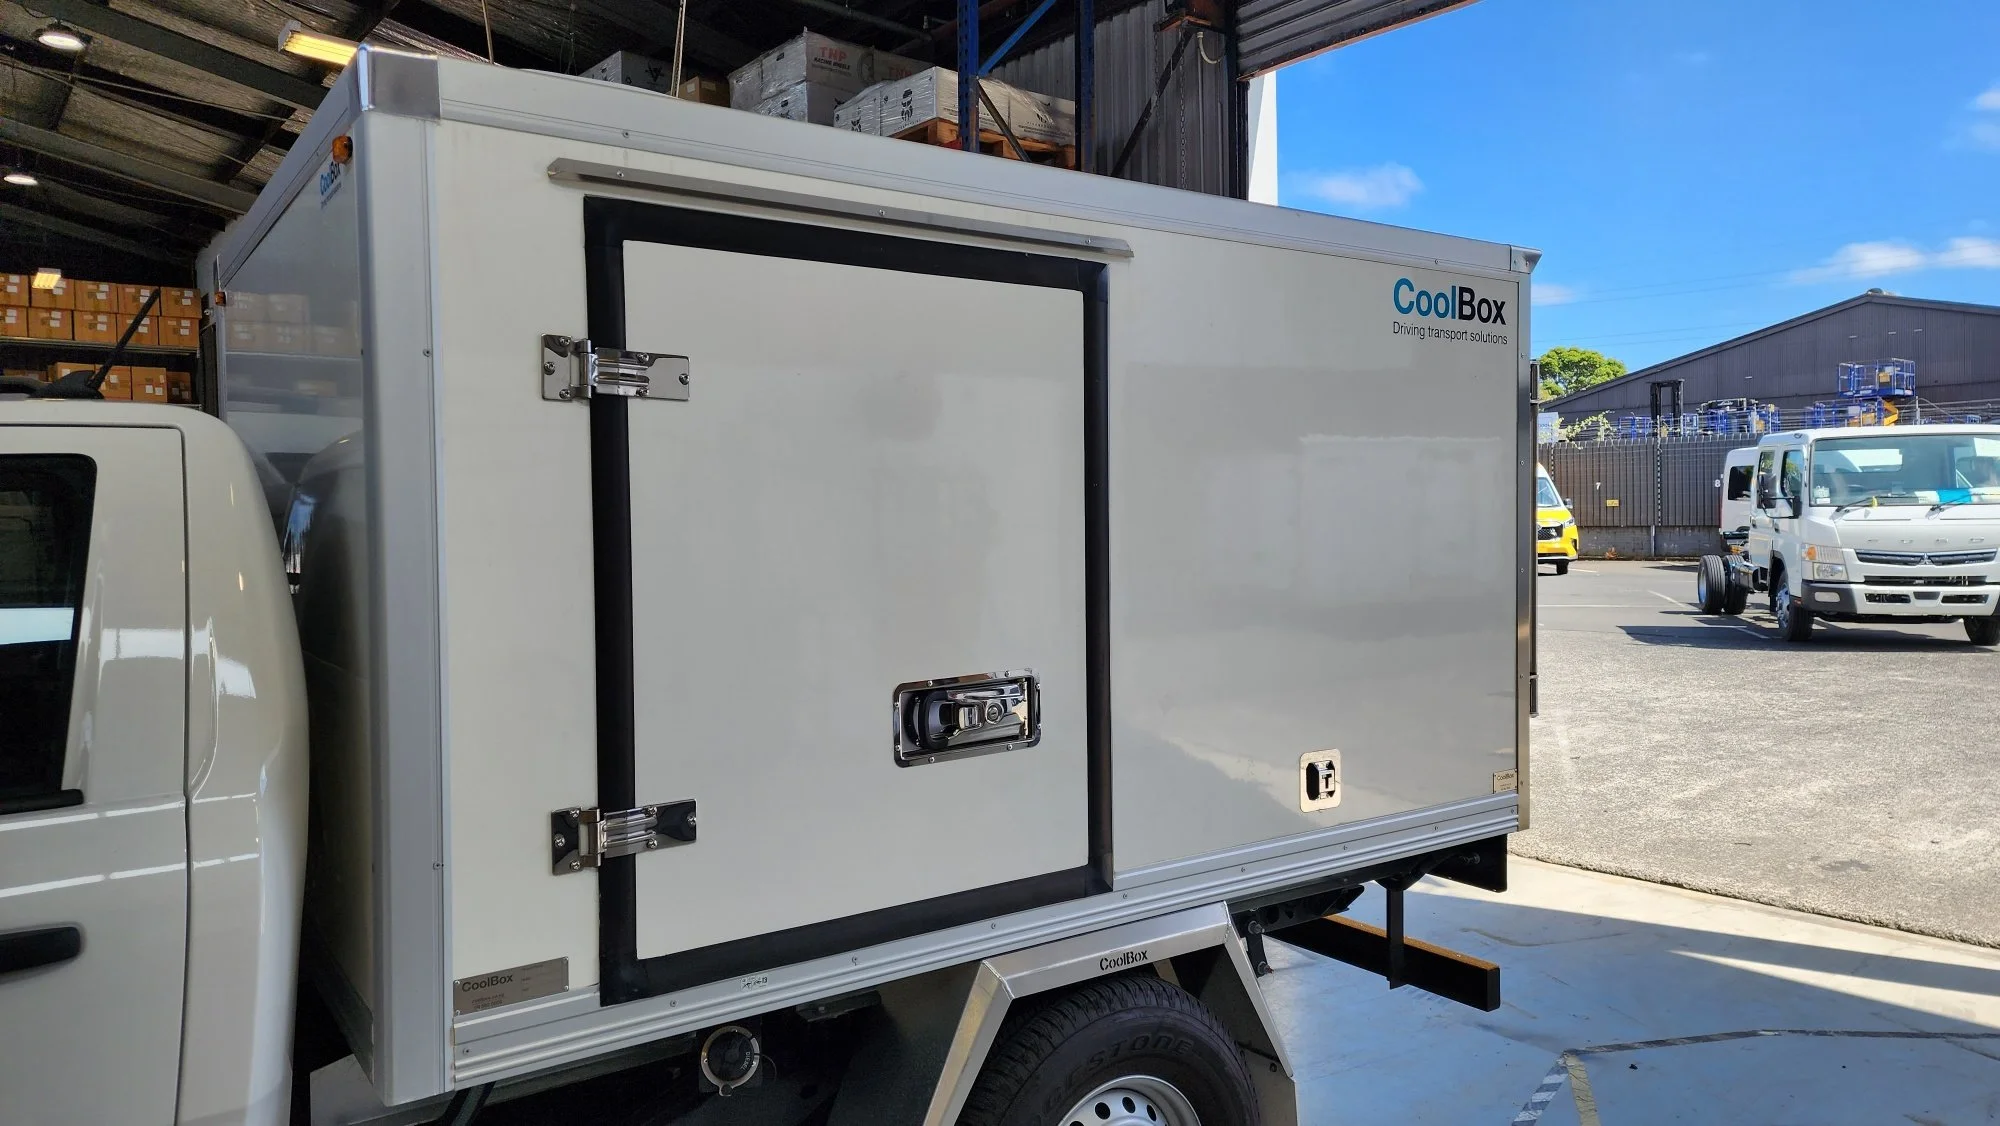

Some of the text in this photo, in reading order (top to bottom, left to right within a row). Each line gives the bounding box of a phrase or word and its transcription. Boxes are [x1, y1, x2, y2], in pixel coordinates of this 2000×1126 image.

[1394, 278, 1506, 325] CoolBox
[1393, 321, 1508, 345] Driving transport solutions
[1595, 482, 1601, 490] 7
[1714, 480, 1721, 488] 8
[1100, 951, 1148, 970] CoolBox
[462, 974, 513, 992] CoolBox
[740, 1052, 751, 1070] DIESEL
